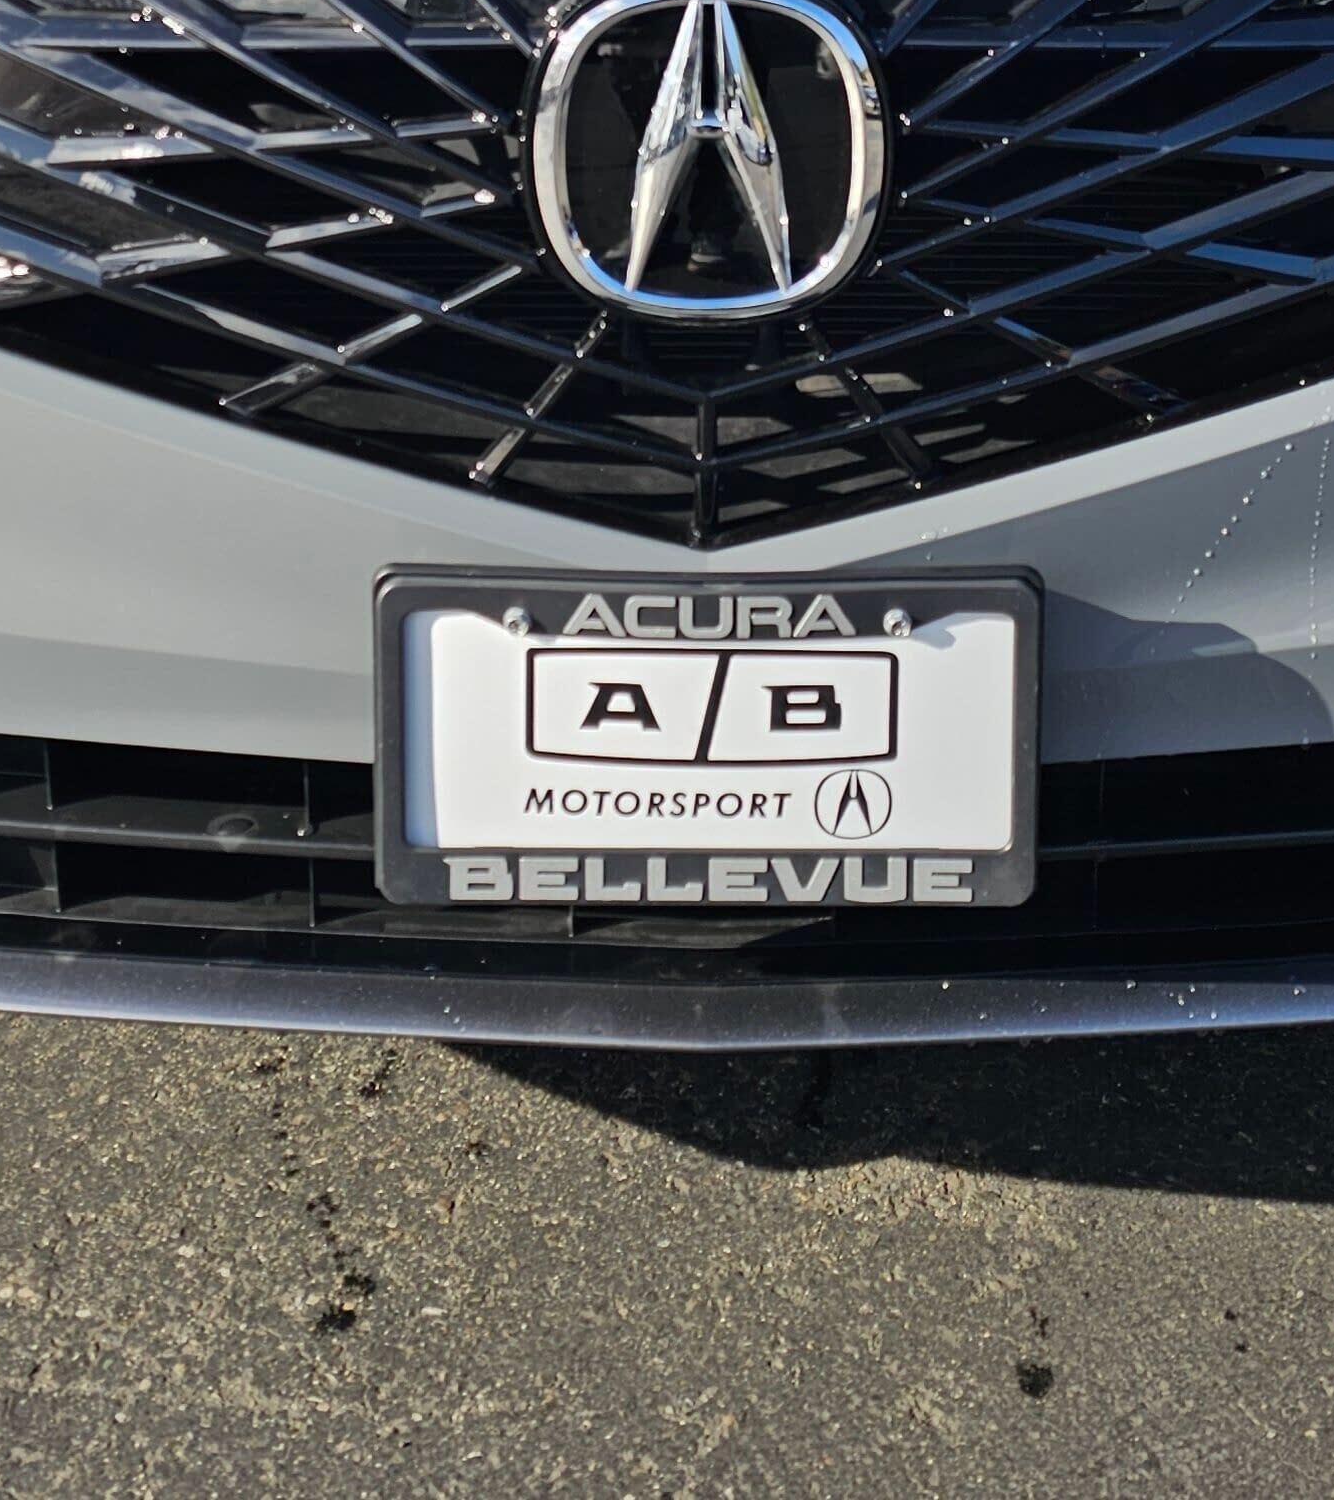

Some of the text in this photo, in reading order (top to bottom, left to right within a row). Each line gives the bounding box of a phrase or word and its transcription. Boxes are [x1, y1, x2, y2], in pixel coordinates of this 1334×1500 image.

[563, 593, 858, 639] ACURA
[524, 787, 793, 819] MOTORSPORT
[443, 855, 974, 902] BELLEVUE
